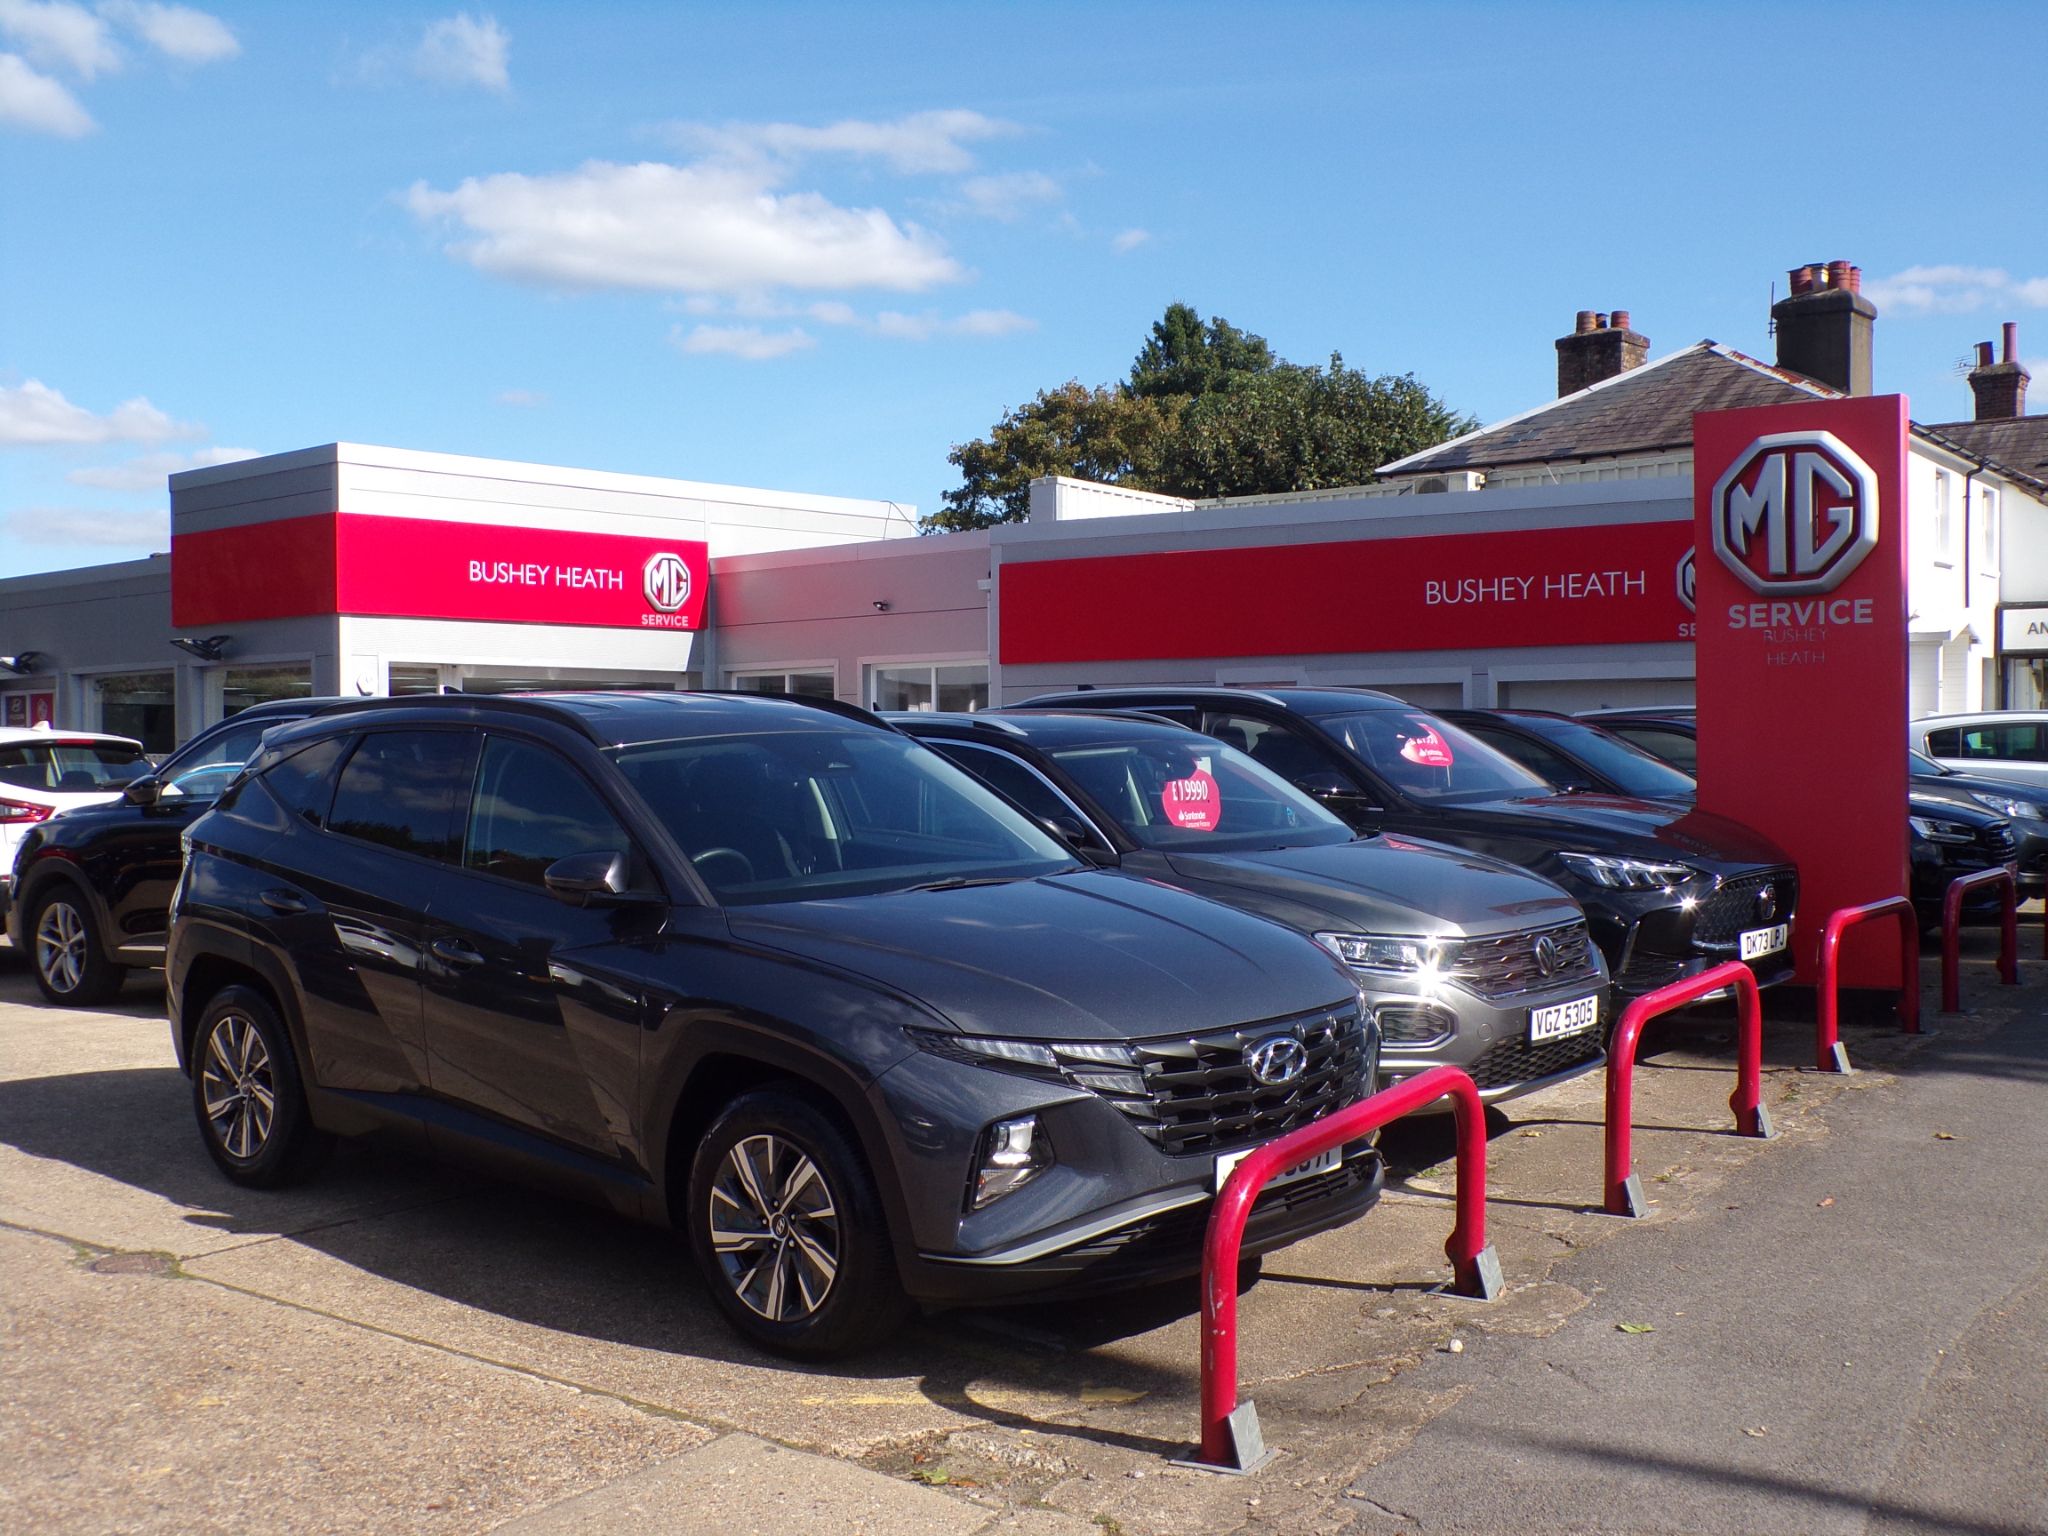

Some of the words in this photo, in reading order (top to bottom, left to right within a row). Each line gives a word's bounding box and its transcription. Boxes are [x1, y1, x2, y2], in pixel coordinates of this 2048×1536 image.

[1729, 451, 1855, 576] MG
[468, 560, 550, 586] BUSHEY
[555, 566, 623, 591] HEATH
[1425, 575, 1535, 605] BUSHEY
[1544, 570, 1645, 599] HEATH
[641, 613, 689, 627] SERVICE
[1728, 598, 1873, 629] SERVICE
[1763, 627, 1828, 643] BUSHEY
[1767, 650, 1825, 665] HEATH
[1536, 1008, 1562, 1036] VGZ
[1564, 999, 1593, 1029] 5305
